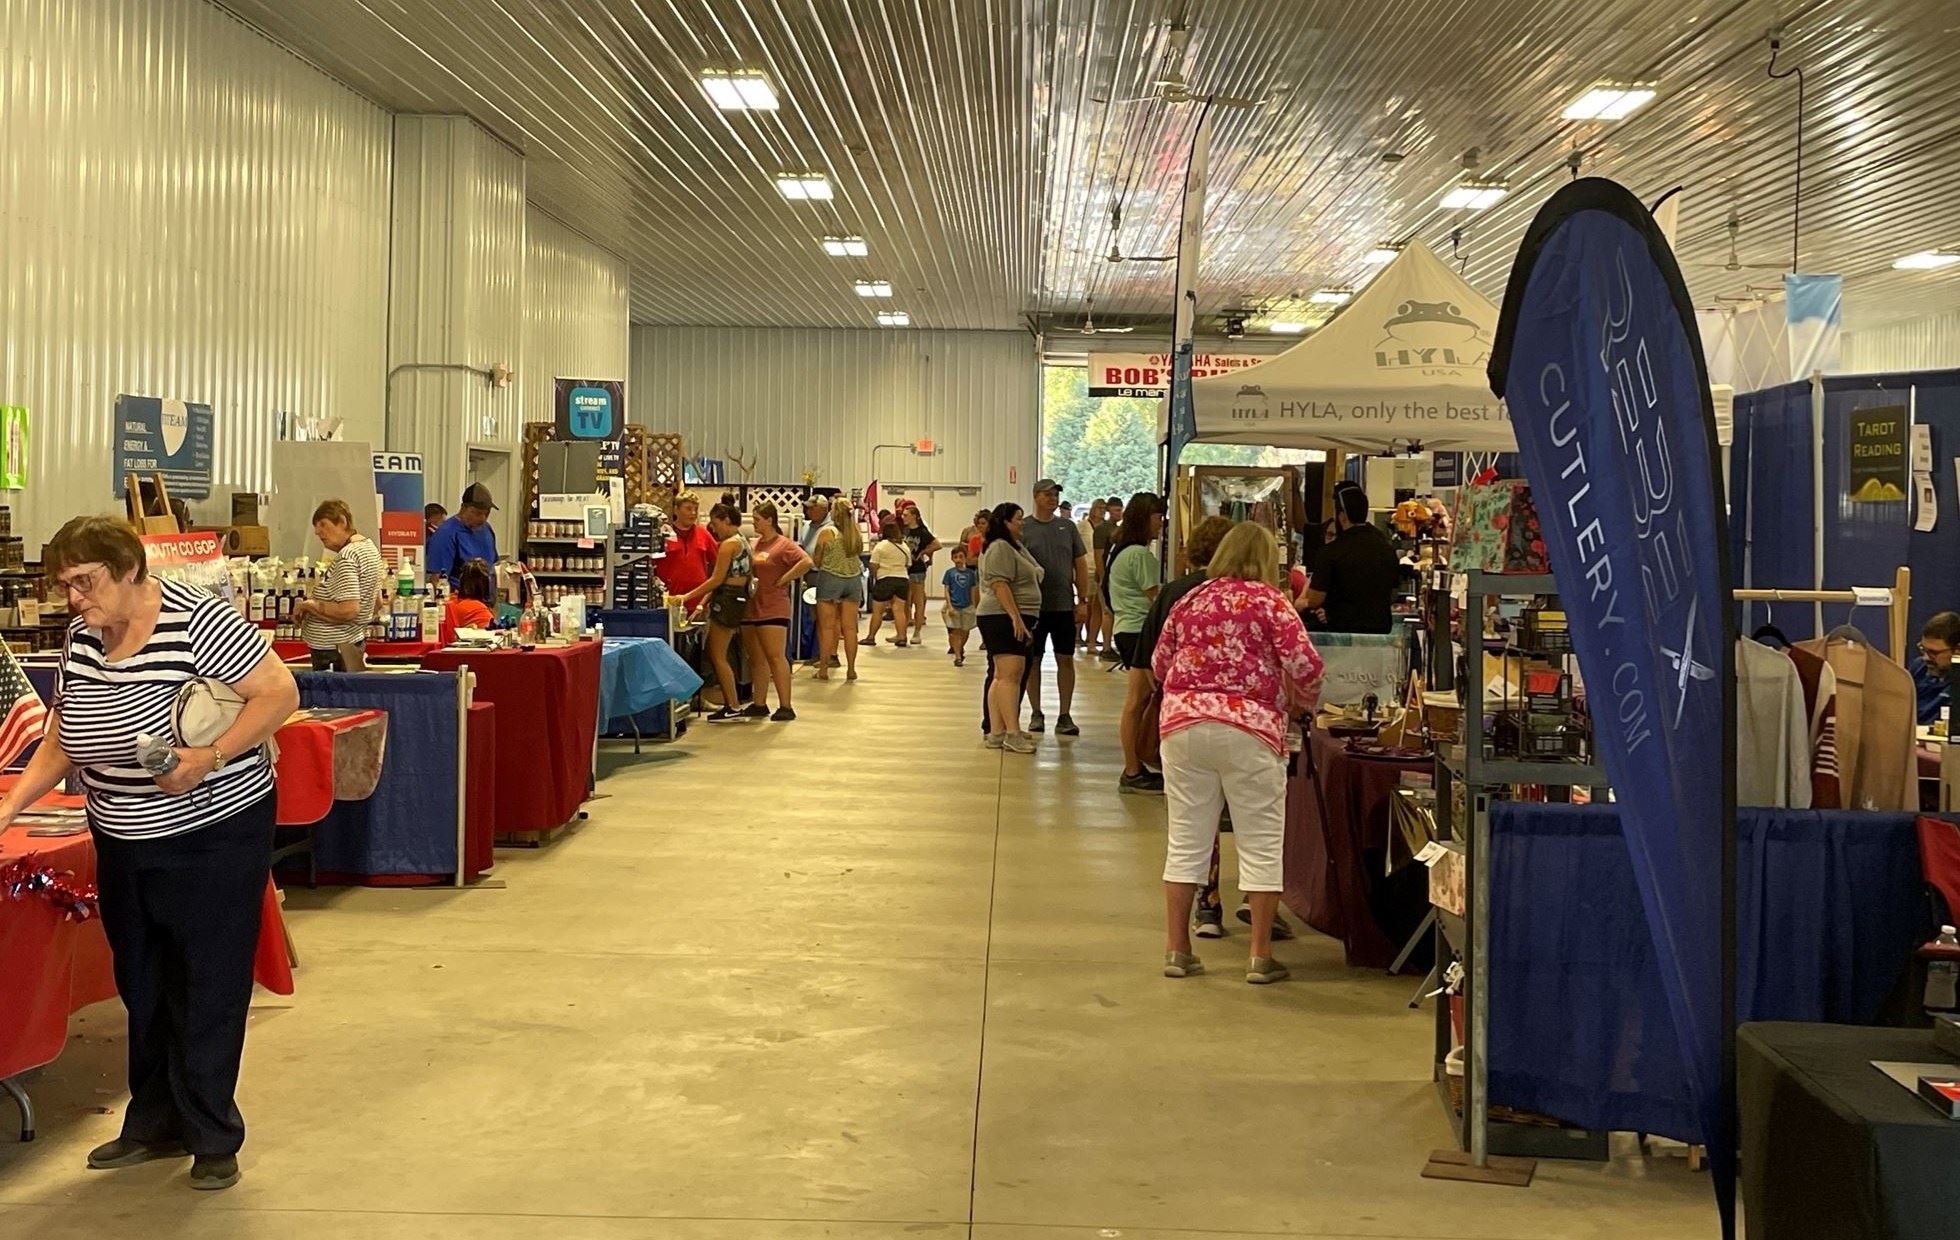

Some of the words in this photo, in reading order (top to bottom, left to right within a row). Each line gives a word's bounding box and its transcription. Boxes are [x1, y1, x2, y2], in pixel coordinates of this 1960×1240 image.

[1161, 354, 1211, 367] YAHA
[1215, 357, 1241, 367] Sales
[1421, 369, 1463, 377] USA
[575, 395, 607, 406] stream
[1280, 402, 1343, 421] HYLA,
[1351, 401, 1397, 423] only
[1404, 401, 1438, 420] the
[1446, 401, 1489, 421] best
[577, 411, 604, 430] TV
[1857, 422, 1896, 437] TAROT
[1854, 442, 1902, 457] READING
[373, 455, 422, 471] EAM
[388, 530, 417, 538] HYDRATE
[178, 541, 194, 556] CO
[194, 540, 216, 555] GOP
